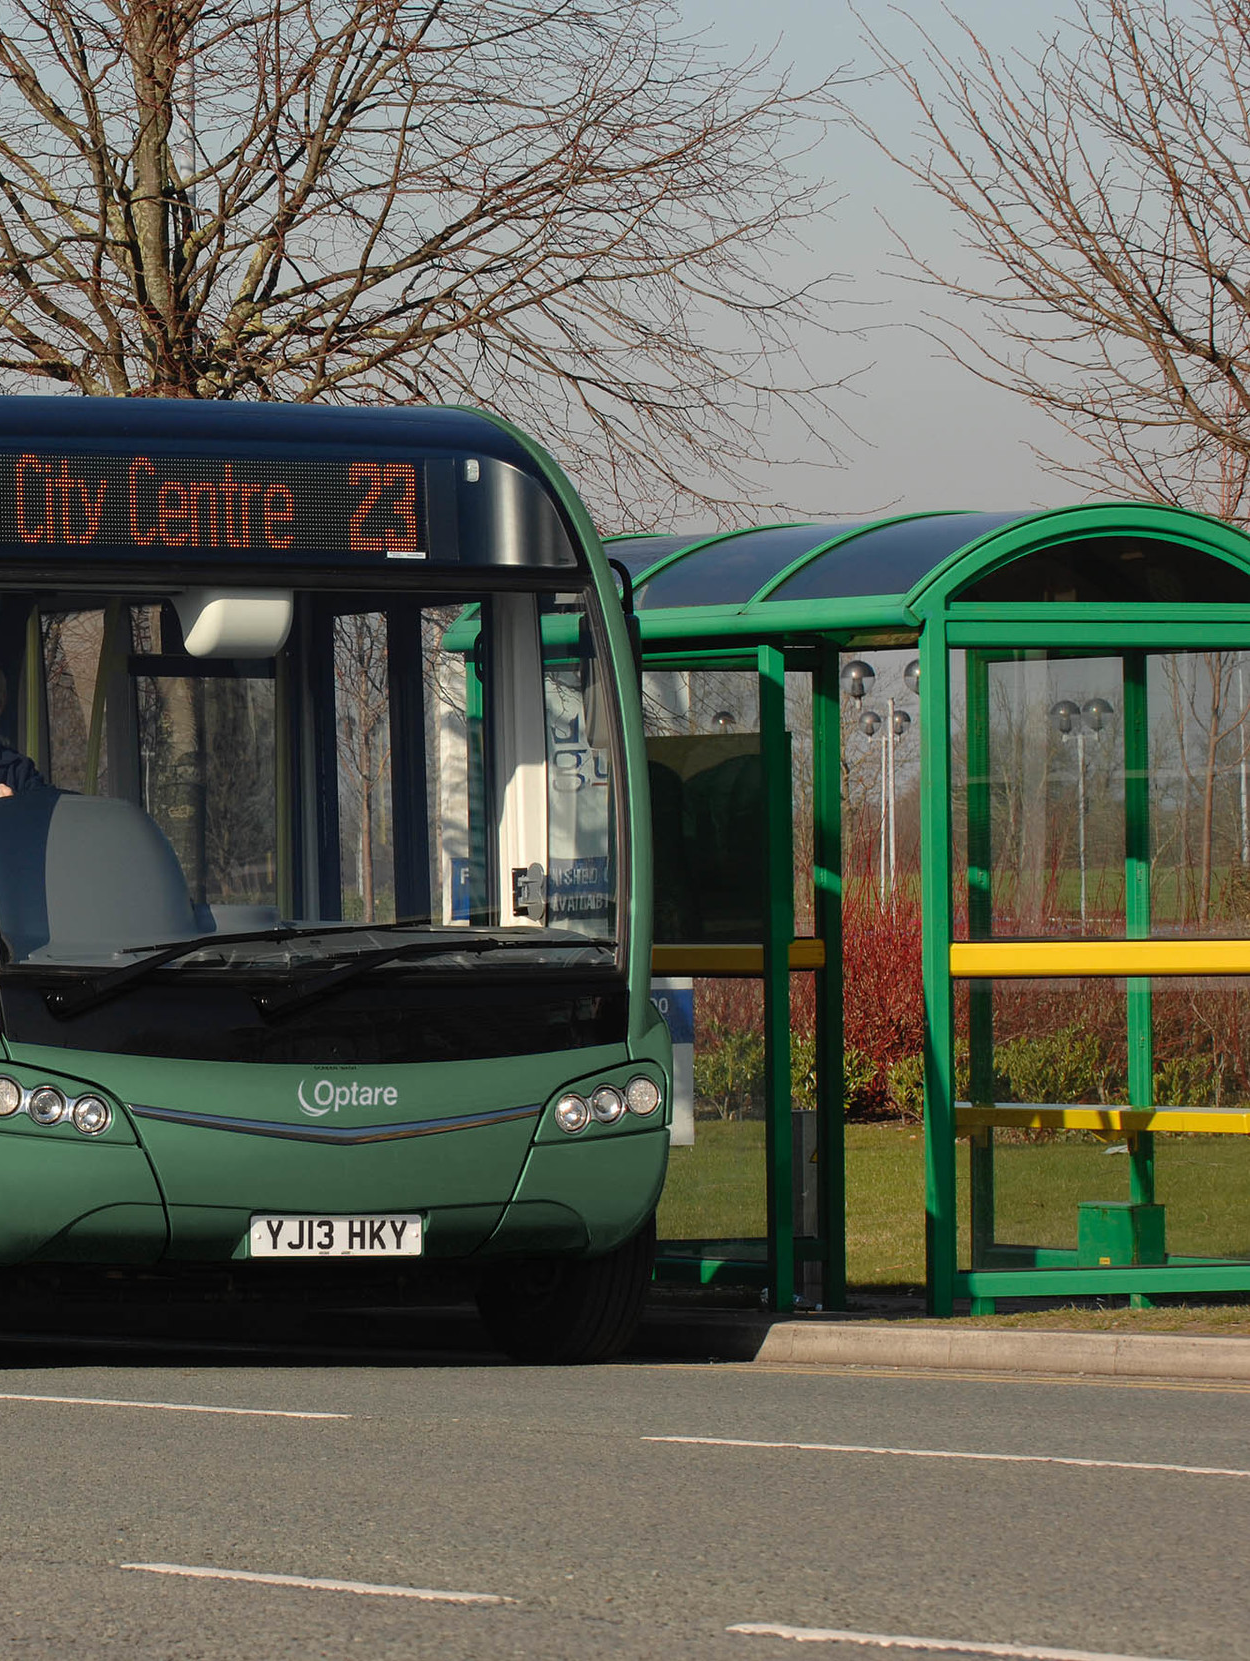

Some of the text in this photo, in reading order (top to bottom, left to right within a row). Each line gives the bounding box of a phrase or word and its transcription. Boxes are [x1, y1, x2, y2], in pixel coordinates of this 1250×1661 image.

[14, 453, 417, 551] City Centre 23
[312, 1079, 398, 1112] Optare
[266, 1219, 408, 1250] YJ13 HKY
